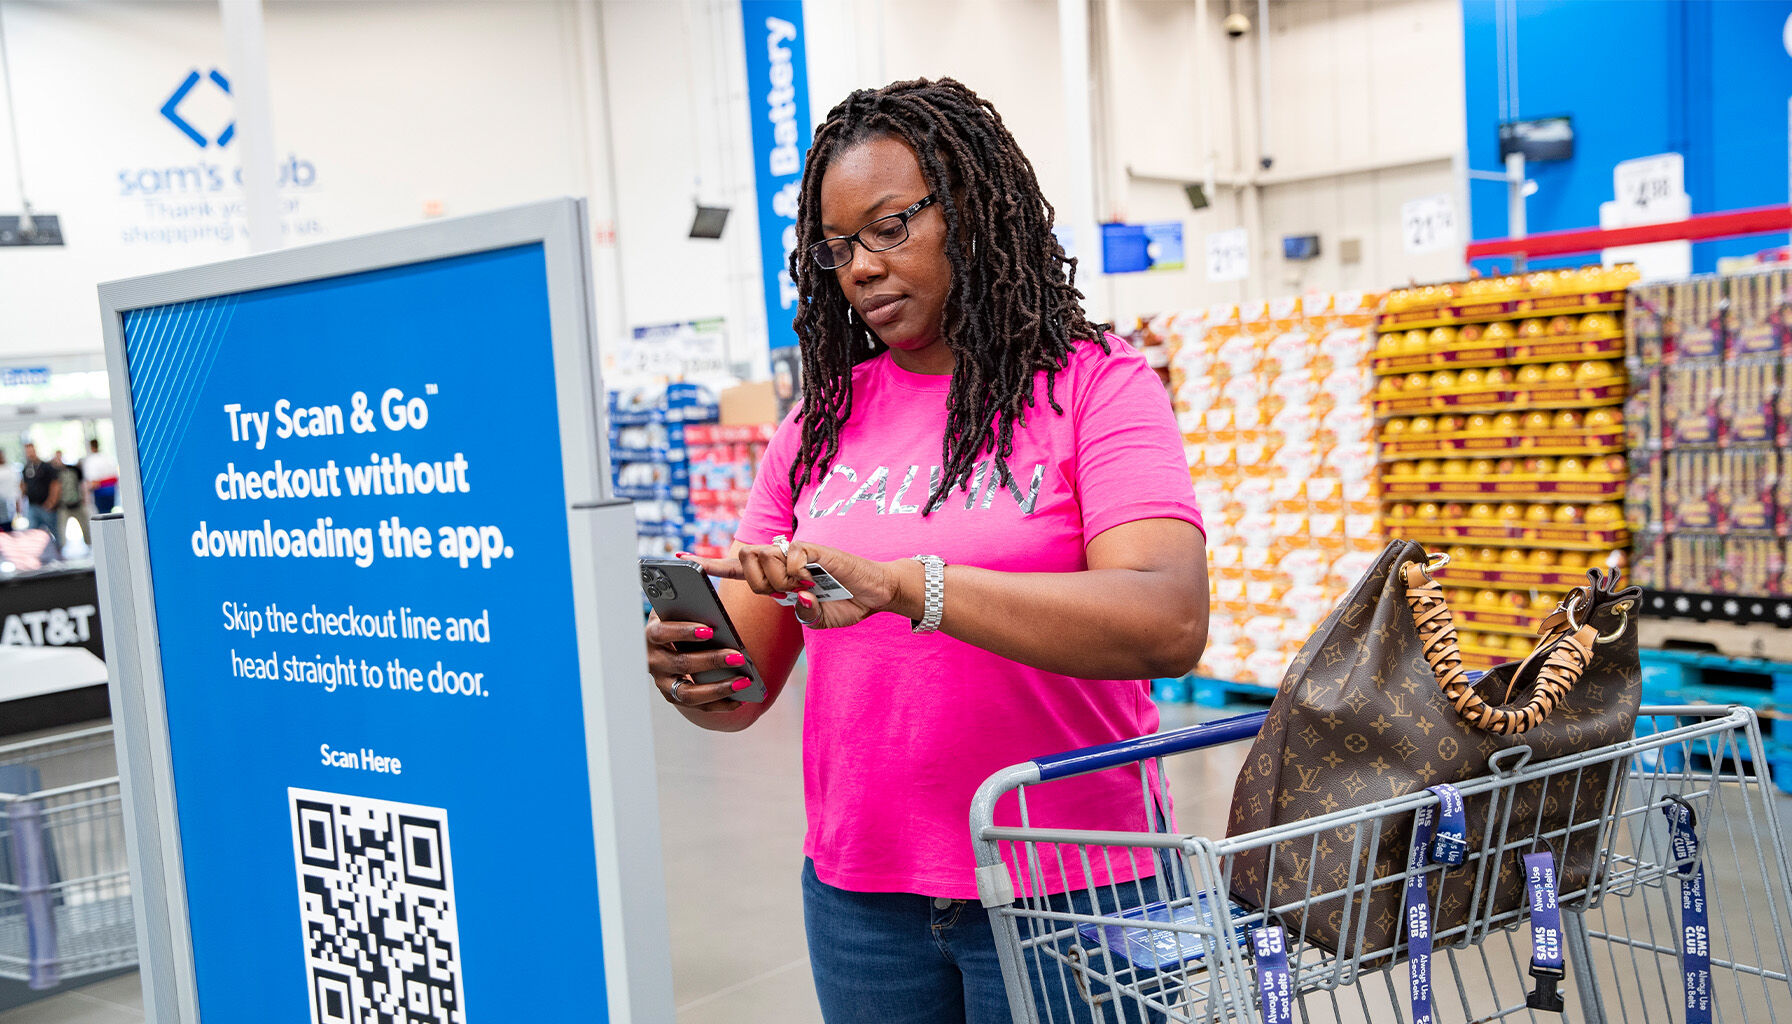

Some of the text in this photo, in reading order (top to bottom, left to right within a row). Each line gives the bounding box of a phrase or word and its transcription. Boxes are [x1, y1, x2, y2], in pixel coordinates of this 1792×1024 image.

[765, 16, 799, 177] Battery
[224, 404, 269, 450] Try
[275, 399, 344, 439] Scan
[350, 391, 376, 433] &
[215, 453, 470, 500] checkout without
[809, 460, 1047, 519] CALVIN
[192, 516, 514, 569] downloading the app.
[0, 604, 97, 647] AT&T
[222, 601, 491, 643] Skip the checkout line and
[231, 648, 489, 697] head straight to the door.
[320, 744, 402, 775] Scan Here
[1673, 837, 1688, 858] CLUB
[1530, 866, 1544, 912] Always Use
[1544, 867, 1556, 909] Seat Belts
[1683, 890, 1691, 910] Belts
[1694, 898, 1704, 913] Use
[1409, 905, 1418, 938] CLUB
[1417, 902, 1428, 939] SAMS
[1685, 926, 1697, 955] CLUB
[1695, 925, 1708, 957] SAMS
[1534, 926, 1547, 960] SAMS
[1546, 928, 1558, 959] CLUB
[1411, 958, 1419, 979] Seat
[1418, 953, 1429, 1001] Always Use
[1263, 970, 1279, 1024] Always Use
[1277, 972, 1290, 1020] Seat Belts
[1686, 972, 1697, 1009] Seat Belts
[1696, 970, 1709, 1011] Always Use
